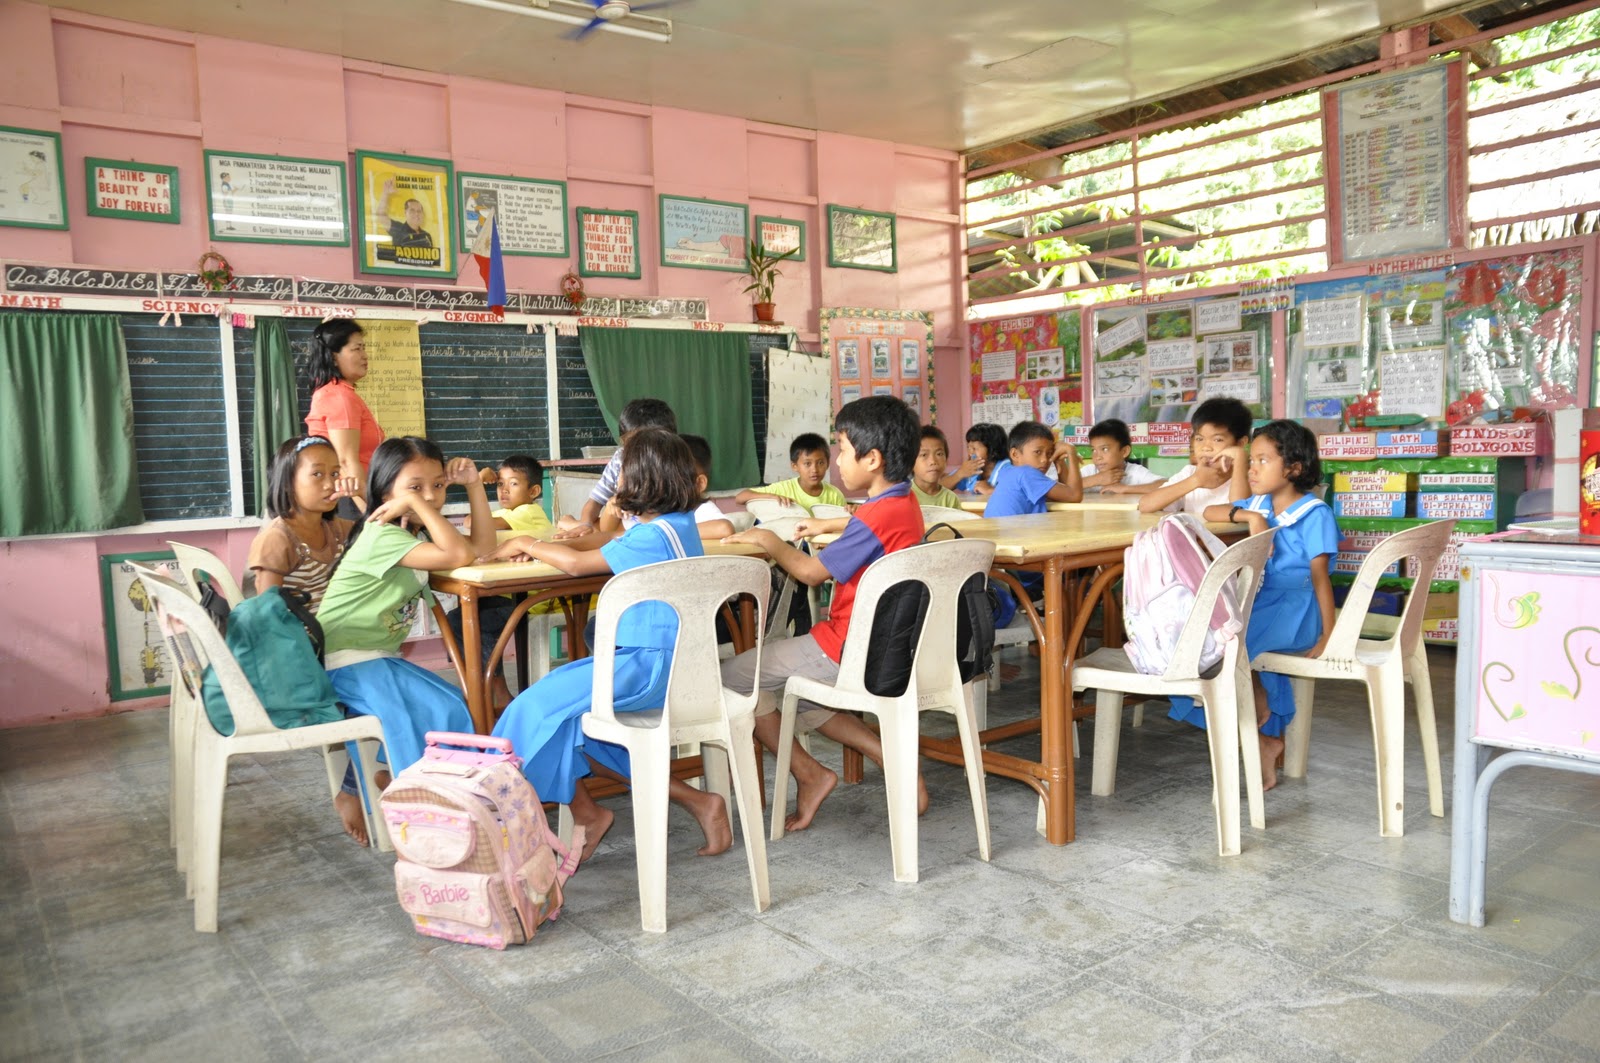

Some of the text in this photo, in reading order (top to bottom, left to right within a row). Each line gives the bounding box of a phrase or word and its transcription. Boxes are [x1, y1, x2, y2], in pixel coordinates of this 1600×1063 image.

[113, 170, 145, 182] THING
[156, 174, 168, 184] OF
[99, 182, 138, 195] BEAUTY
[148, 188, 157, 197] IS
[100, 197, 119, 209] JOY
[594, 215, 605, 223] NOT
[609, 215, 620, 224] TRY
[584, 223, 631, 234] HAVE THE BEST
[762, 223, 787, 232] HONESTY
[586, 233, 627, 243] THINGS FOR
[396, 247, 439, 259] AQUINO
[585, 242, 632, 253] YOURSELF TRY
[586, 252, 631, 263] TO THE BEST
[588, 262, 600, 271] FOR
[1369, 254, 1453, 275] MATHEMATICS
[1240, 276, 1295, 296] THEMATIC
[1, 295, 62, 309] MATH
[1128, 294, 1164, 305] SCIENCE
[444, 312, 503, 322] CE/GMRC
[1002, 319, 1033, 331] ENGLISH
[1392, 434, 1420, 443] MATH
[1452, 428, 1535, 439] KINDS OF
[1402, 446, 1438, 454] PAPERS
[1452, 442, 1535, 453] POLYGONS
[420, 884, 469, 905] Barbie
